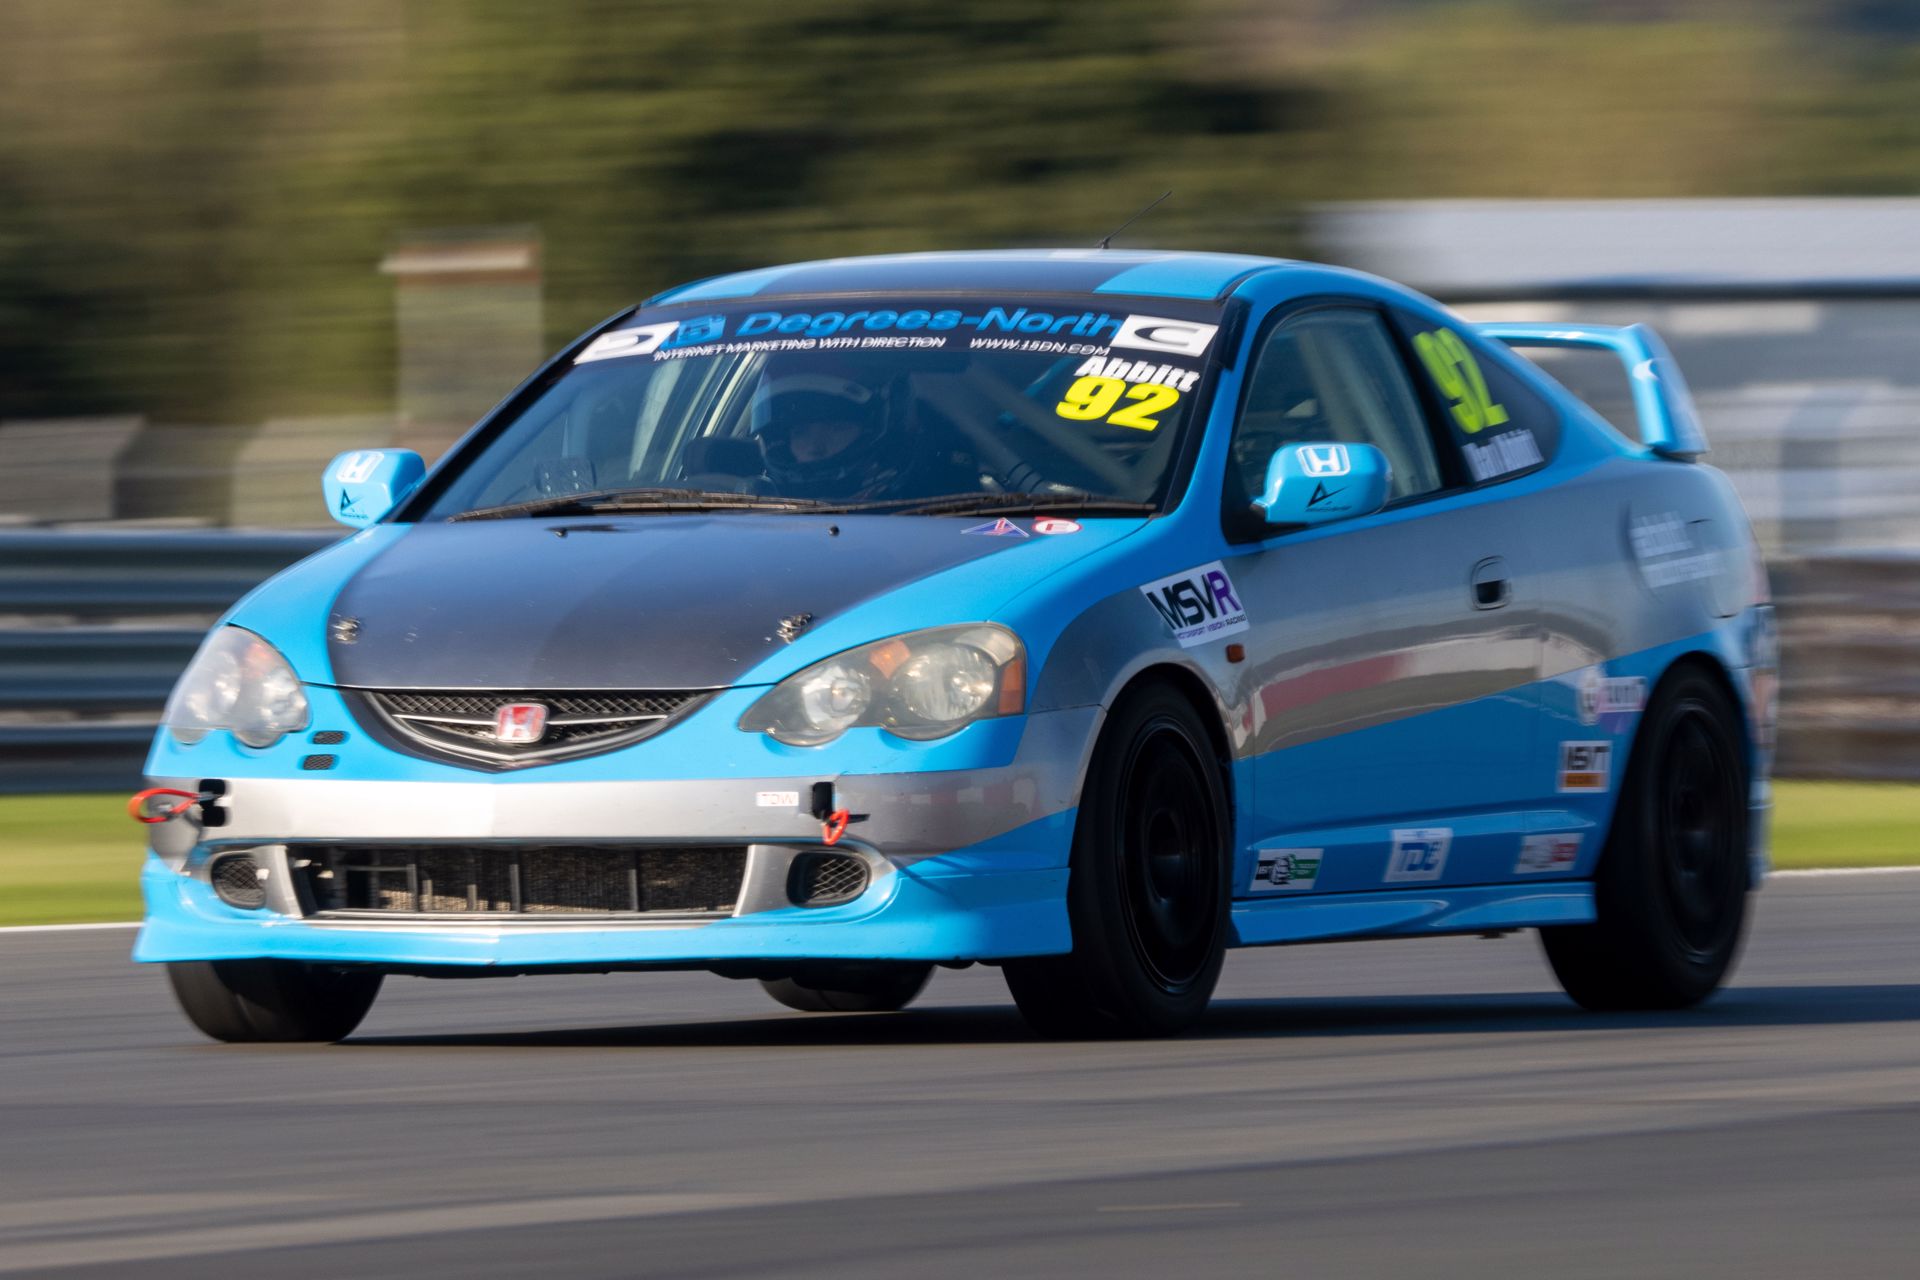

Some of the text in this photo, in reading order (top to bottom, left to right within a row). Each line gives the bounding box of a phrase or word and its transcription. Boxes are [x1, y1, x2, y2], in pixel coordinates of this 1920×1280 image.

[653, 336, 947, 361] INTERNET MARKETING WITH DIRECTION
[1074, 354, 1200, 392] Abbitt
[1056, 375, 1180, 432] 92
[1411, 326, 1510, 434] 92
[1146, 569, 1242, 630] MSVR
